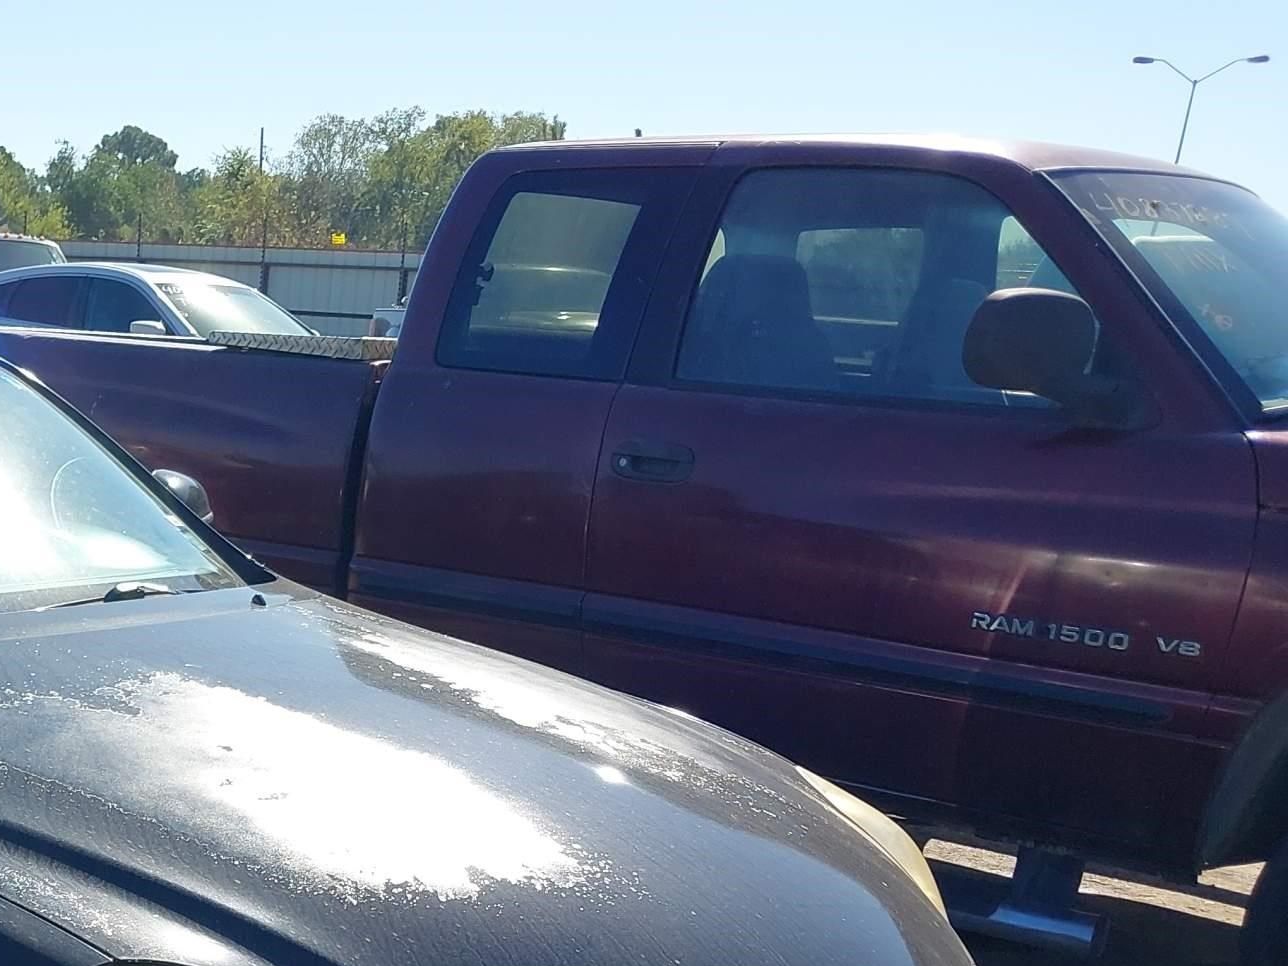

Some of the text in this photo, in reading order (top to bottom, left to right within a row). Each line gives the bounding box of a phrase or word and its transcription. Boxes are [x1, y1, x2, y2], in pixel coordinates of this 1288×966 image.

[971, 612, 1202, 657] RAM 1500 V8
